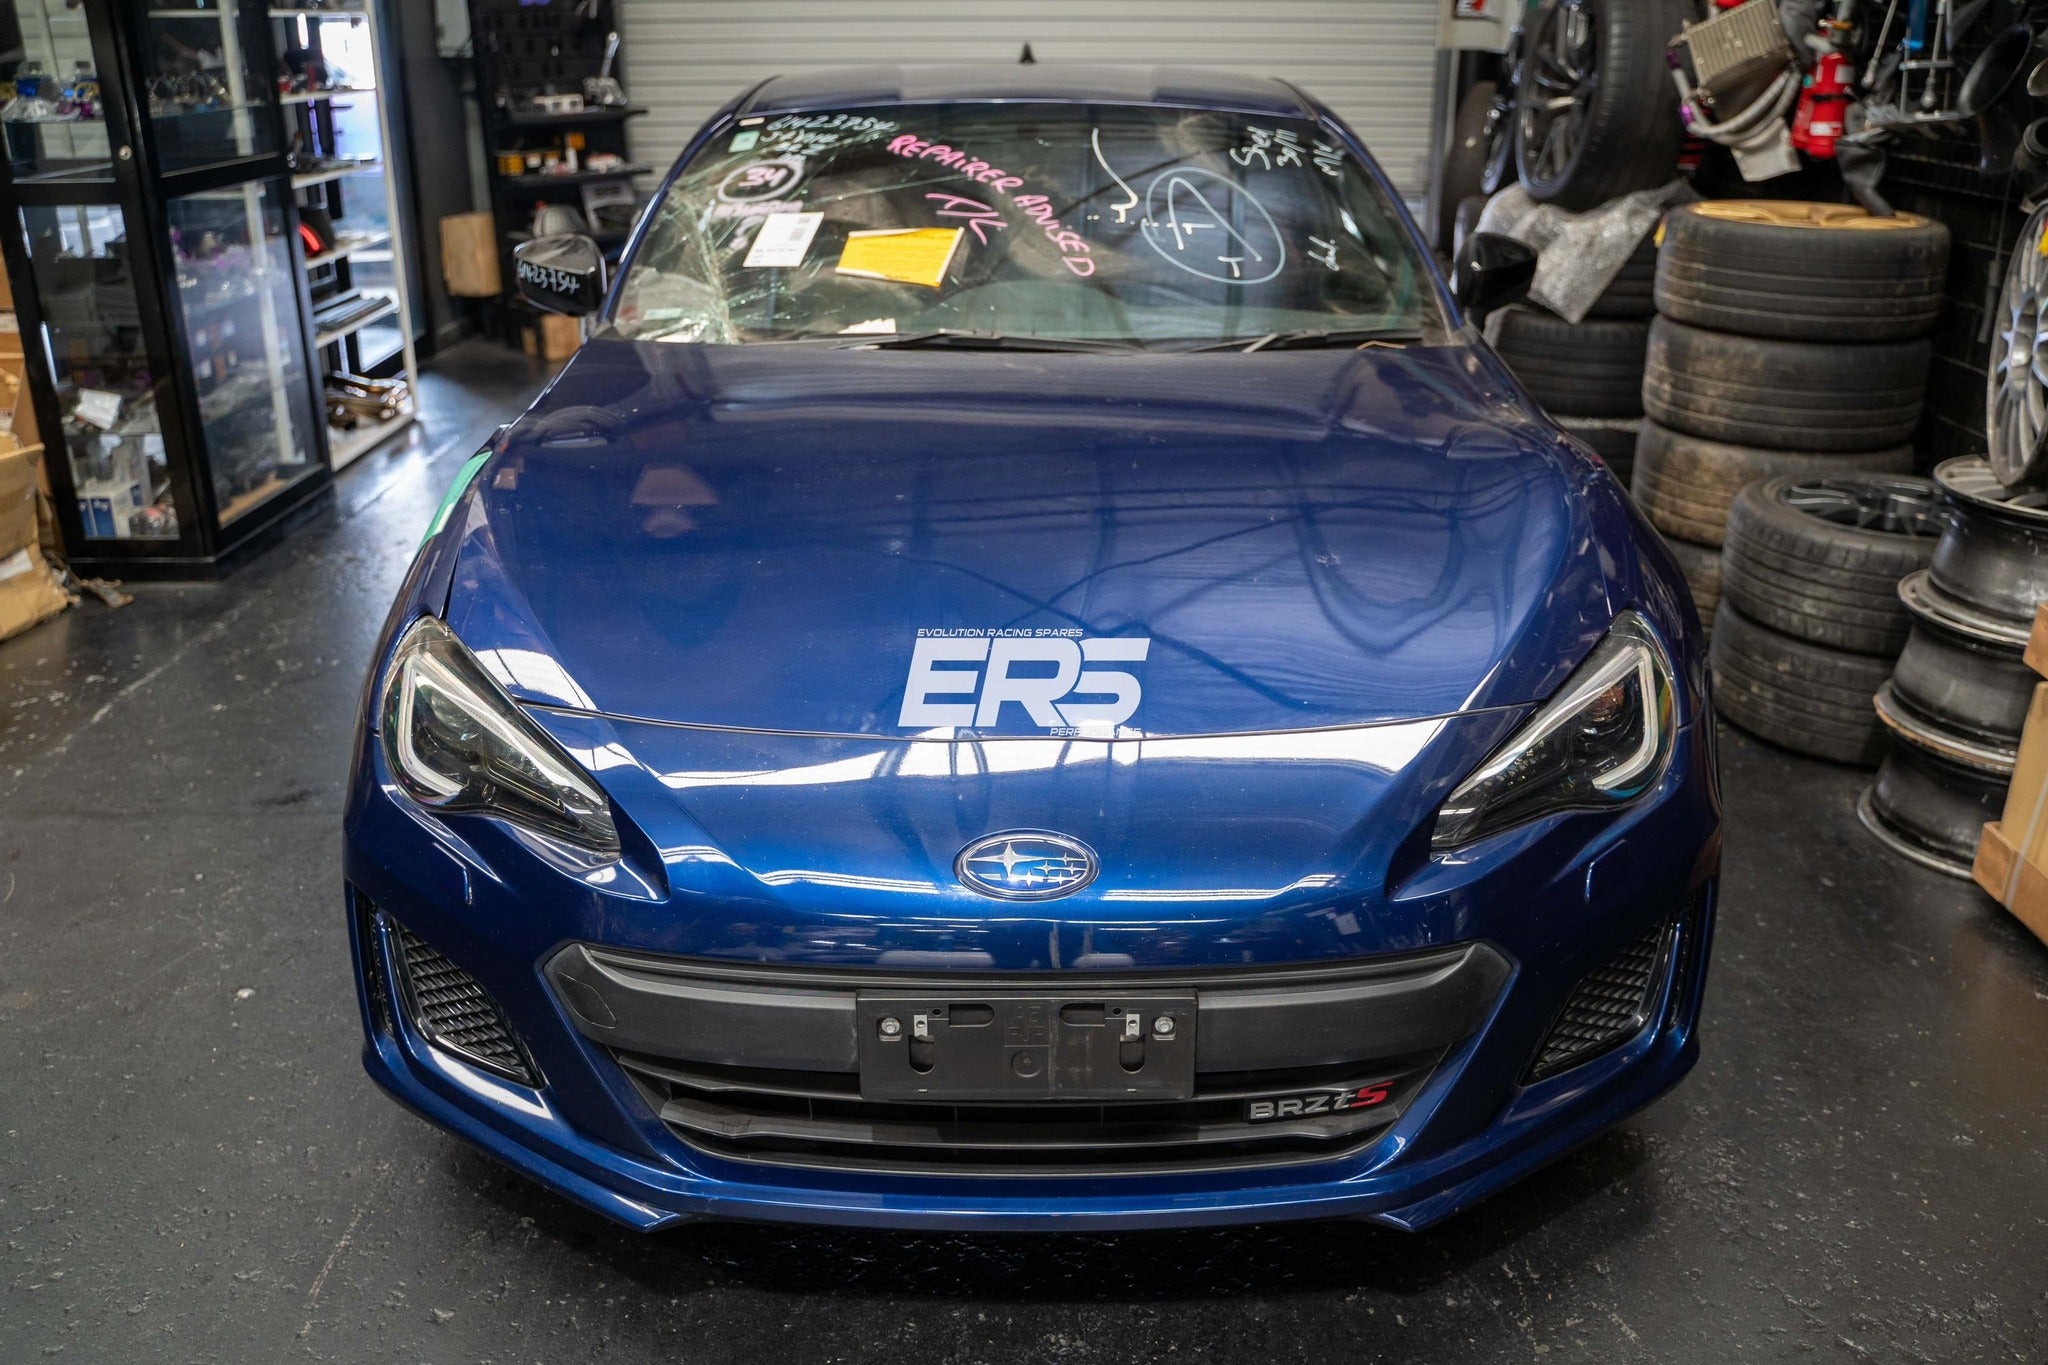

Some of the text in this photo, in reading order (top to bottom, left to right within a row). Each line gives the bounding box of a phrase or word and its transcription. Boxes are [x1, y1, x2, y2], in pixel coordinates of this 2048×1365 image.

[886, 134, 1025, 194] REPAIRER
[1013, 194, 1096, 277] ADVISED
[916, 628, 1084, 638] EVOLUTION RACING SPARES
[896, 637, 1151, 728] ERS
